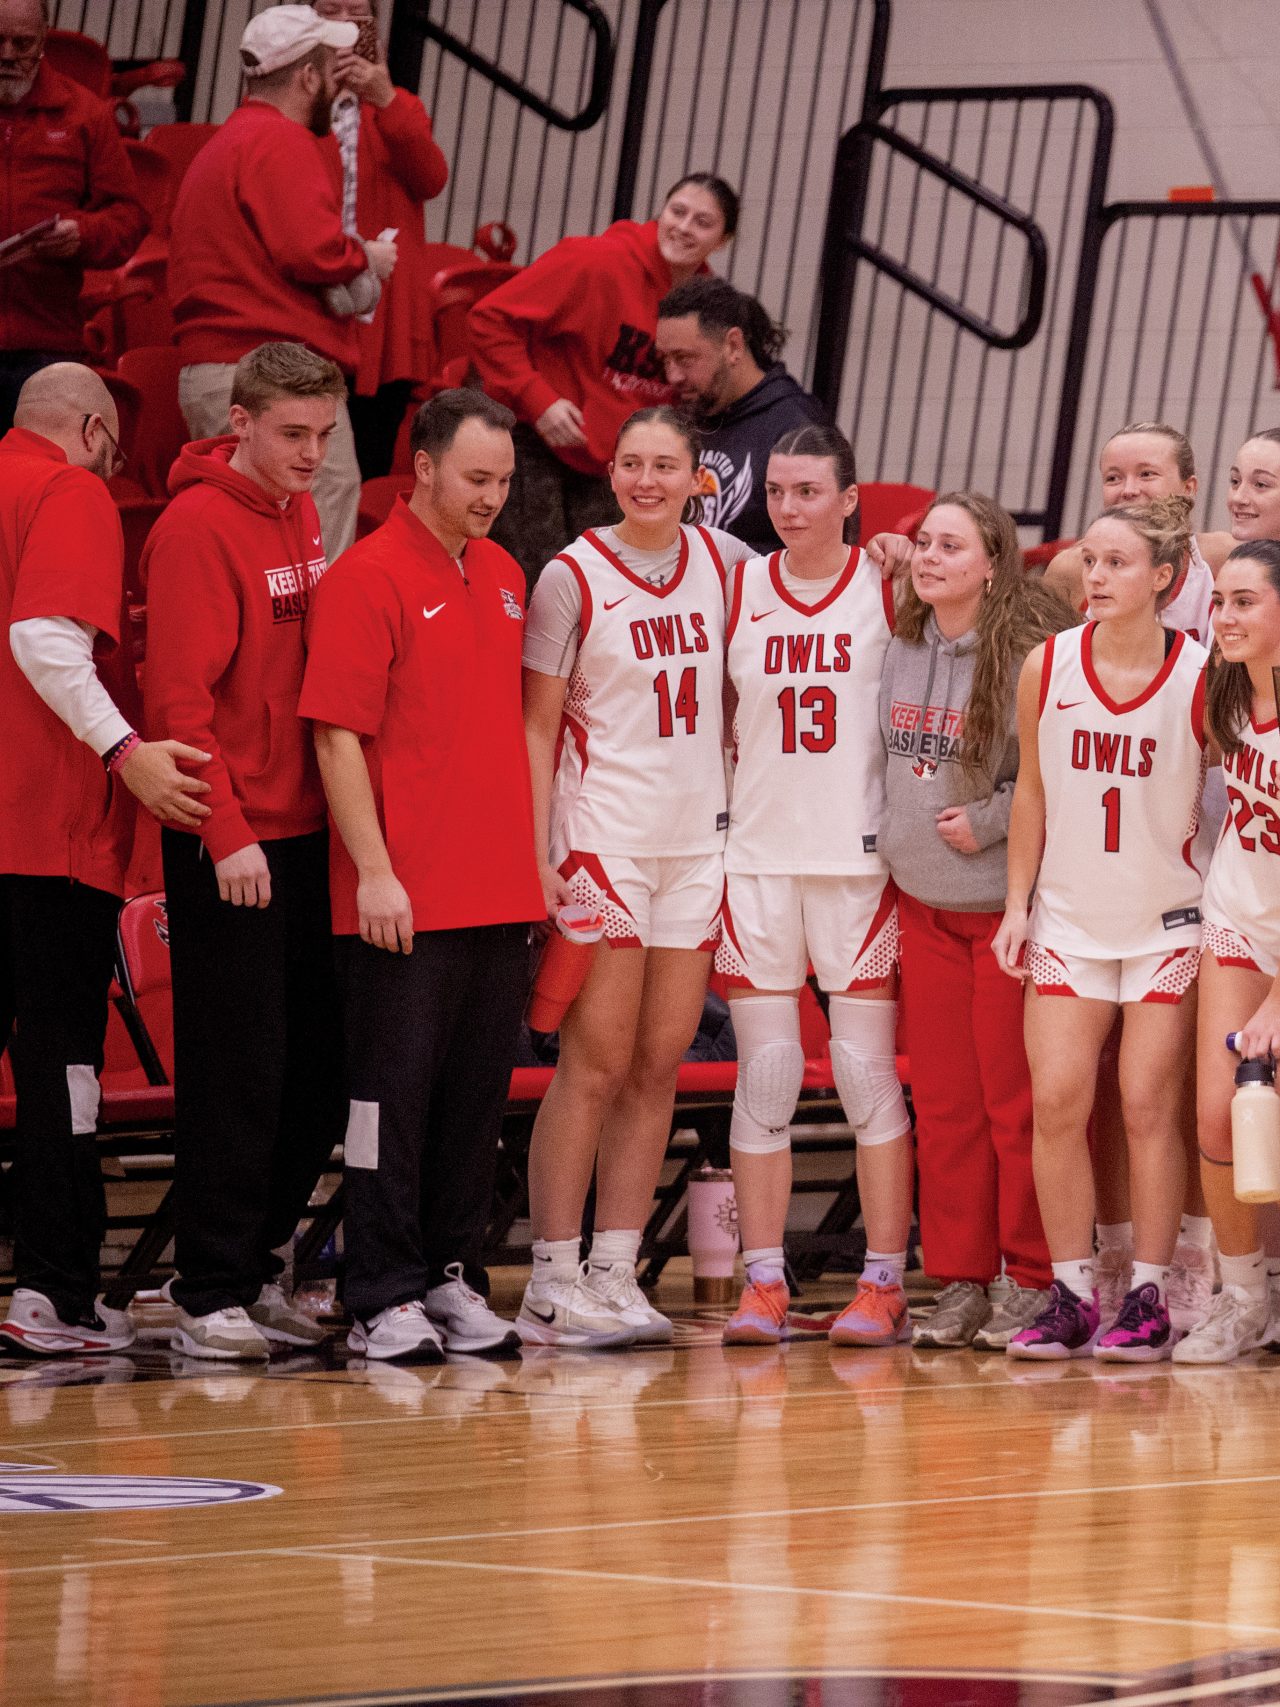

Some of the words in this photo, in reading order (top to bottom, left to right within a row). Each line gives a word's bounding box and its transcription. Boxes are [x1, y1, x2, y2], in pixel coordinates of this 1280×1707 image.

[629, 612, 710, 660] OWLS
[764, 633, 851, 674] OWLS
[653, 667, 699, 737] 14
[777, 686, 837, 753] 13
[1071, 729, 1156, 777] OWLS
[1101, 787, 1121, 853] 1
